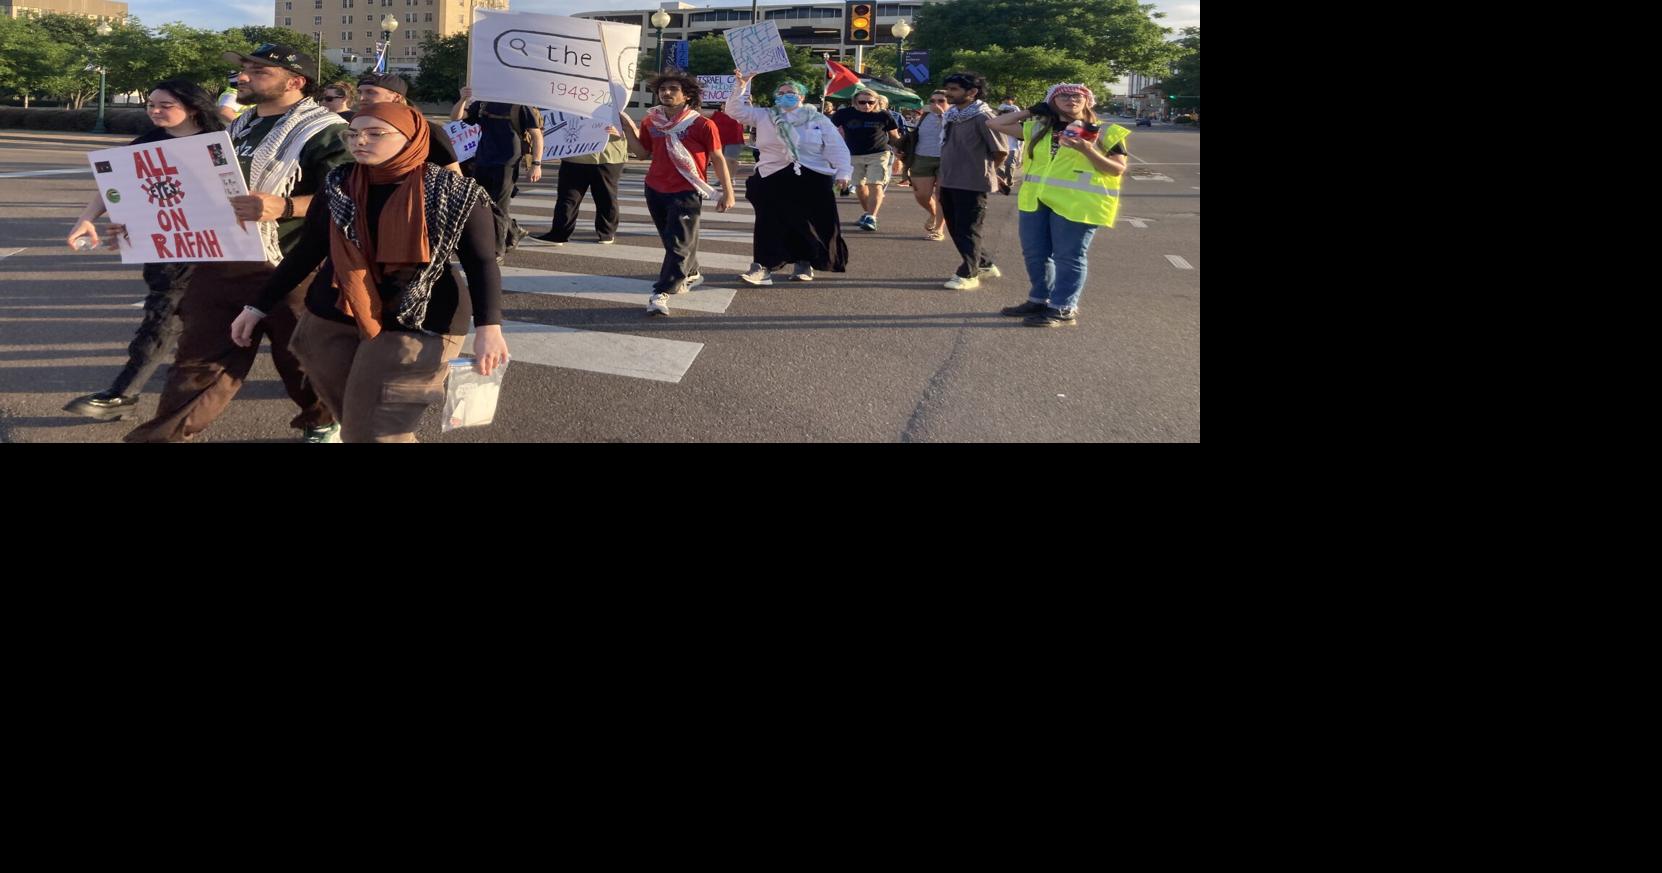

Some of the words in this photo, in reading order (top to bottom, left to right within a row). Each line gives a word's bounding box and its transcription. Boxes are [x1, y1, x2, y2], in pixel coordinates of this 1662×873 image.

[546, 44, 592, 67] the
[698, 76, 722, 84] ISRAEL
[727, 76, 738, 84] CA
[550, 81, 611, 107] 1948-20
[133, 147, 179, 178] ALL
[150, 182, 179, 199] EYES
[157, 208, 189, 231] ON
[151, 230, 223, 259] RAFAH
